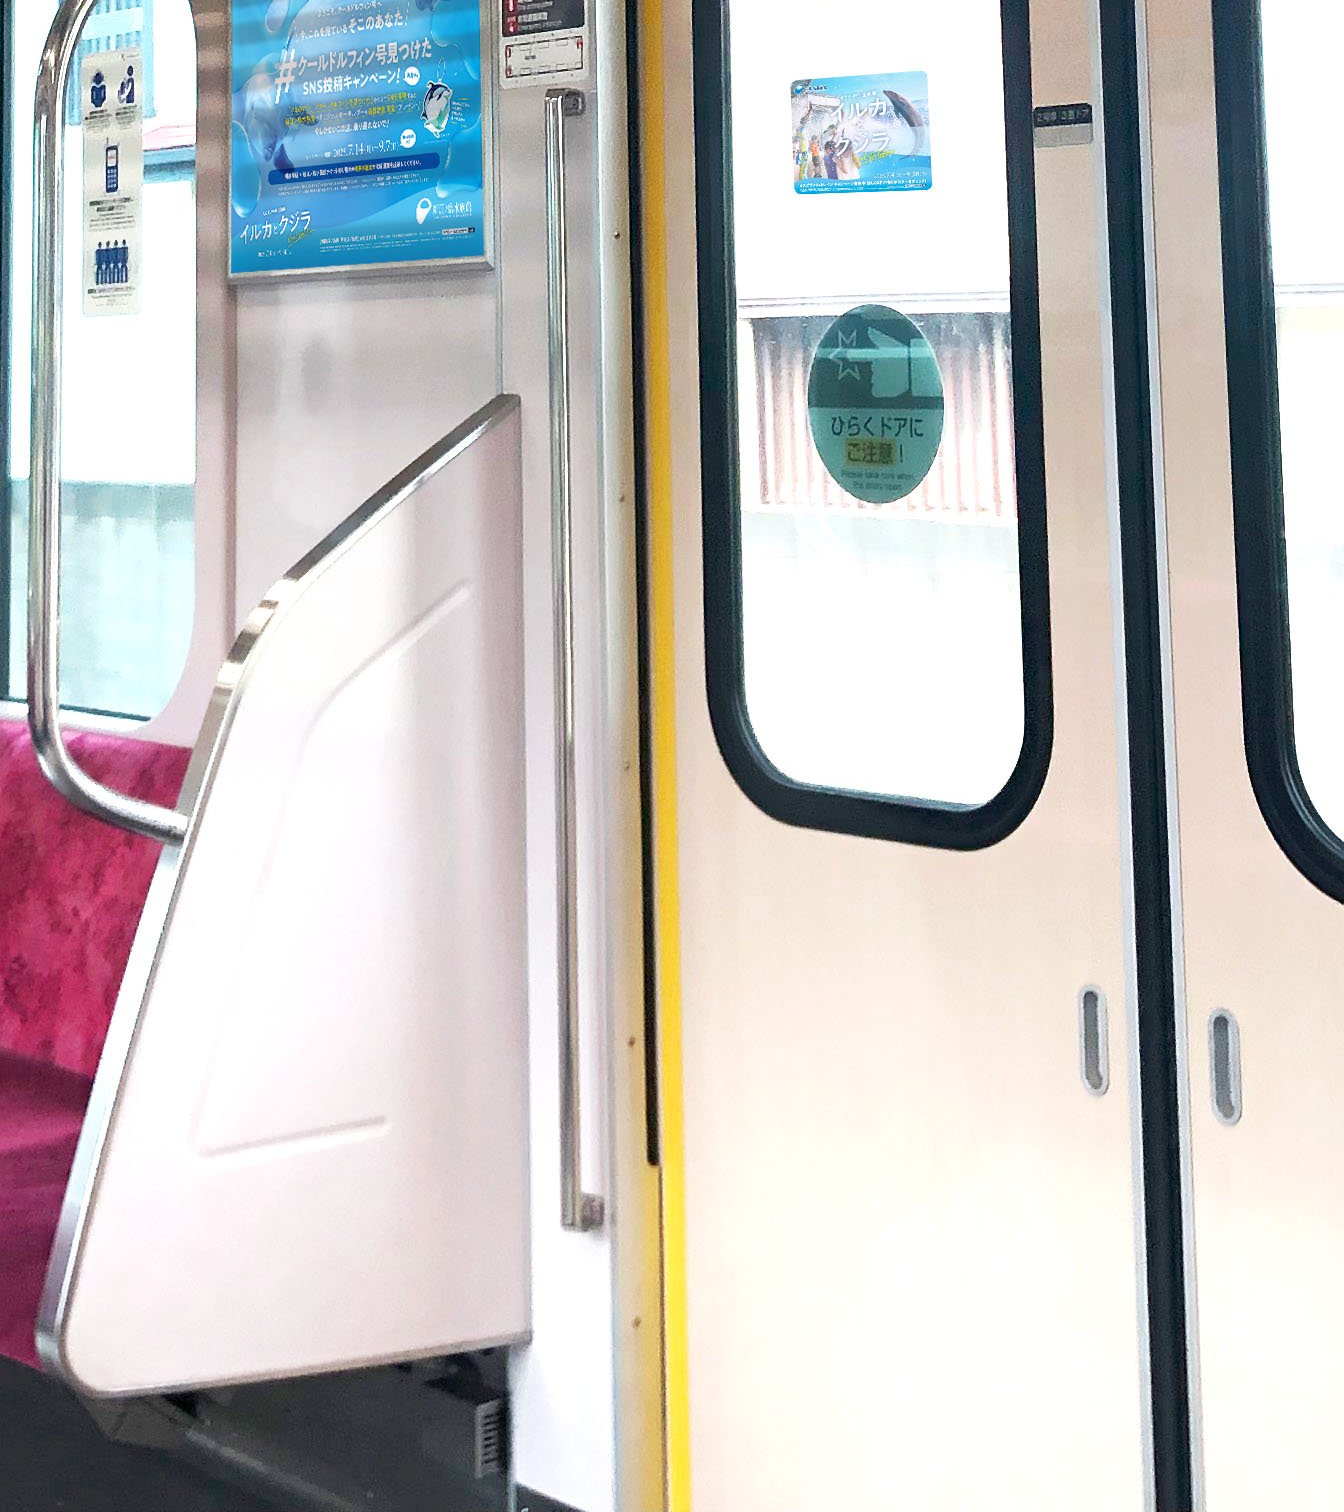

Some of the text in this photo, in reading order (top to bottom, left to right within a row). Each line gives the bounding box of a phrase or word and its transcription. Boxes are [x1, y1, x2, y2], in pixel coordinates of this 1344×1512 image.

[831, 98, 887, 122] イルカ
[834, 132, 889, 157] クジラ
[240, 210, 312, 246] イルカとクジラ
[831, 416, 924, 438] ひらくドアに
